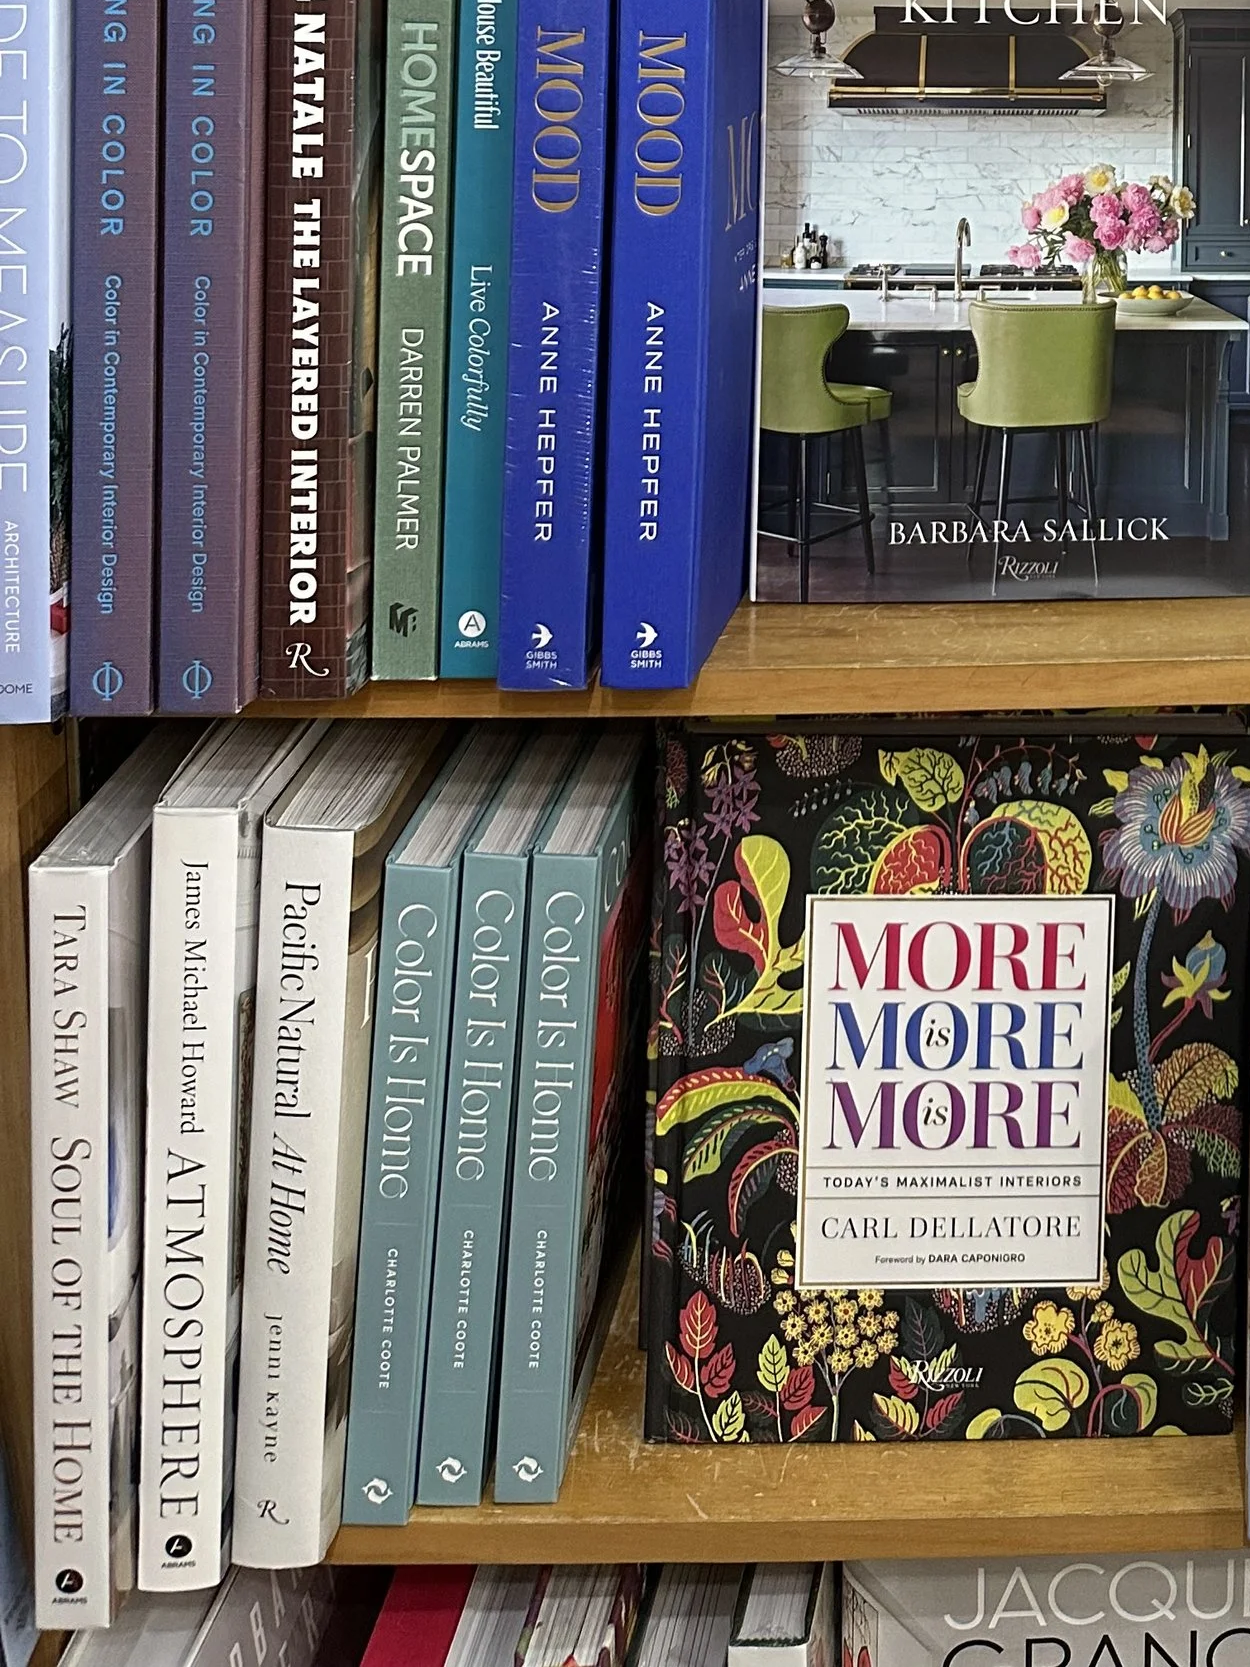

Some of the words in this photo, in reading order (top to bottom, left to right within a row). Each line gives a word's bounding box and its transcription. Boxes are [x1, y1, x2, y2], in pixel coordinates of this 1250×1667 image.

[396, 22, 439, 277] HOMESPACE
[634, 30, 687, 217] MOOD
[105, 275, 121, 324] Color
[105, 331, 120, 345] in
[644, 302, 664, 394] ANNE
[100, 352, 120, 479] Contemporary
[397, 328, 424, 437] DARREN
[395, 446, 422, 551] PALMER
[639, 408, 661, 541] HEPFER
[102, 485, 118, 548] Interior
[889, 520, 1032, 545] BARBARA
[1043, 517, 1170, 543] SALLICK
[97, 554, 117, 614] Design
[181, 858, 208, 930] James
[181, 939, 207, 1032] Michael
[539, 891, 585, 1009] Color
[828, 921, 1086, 992] MORE
[537, 1019, 577, 1048] Is
[825, 1000, 1084, 1071] MORE
[180, 1040, 205, 1135] Howard
[528, 1061, 575, 1182] Home
[822, 1079, 1081, 1150] MORE
[824, 1176, 890, 1188] TODAY'S
[896, 1176, 993, 1188] MAXIMALIST
[1000, 1175, 1082, 1188] INTERIORS
[821, 1216, 897, 1239] CARL
[910, 1215, 1081, 1239] DELLATORE
[875, 1254, 913, 1264] Foreword
[916, 1254, 926, 1265] by
[928, 1253, 958, 1264] DARA
[962, 1253, 1026, 1264] CAPONIGRO
[532, 1230, 547, 1314] CHARLOTTE
[159, 1148, 206, 1520] ATMOSPHERE
[528, 1320, 542, 1369] COOTE
